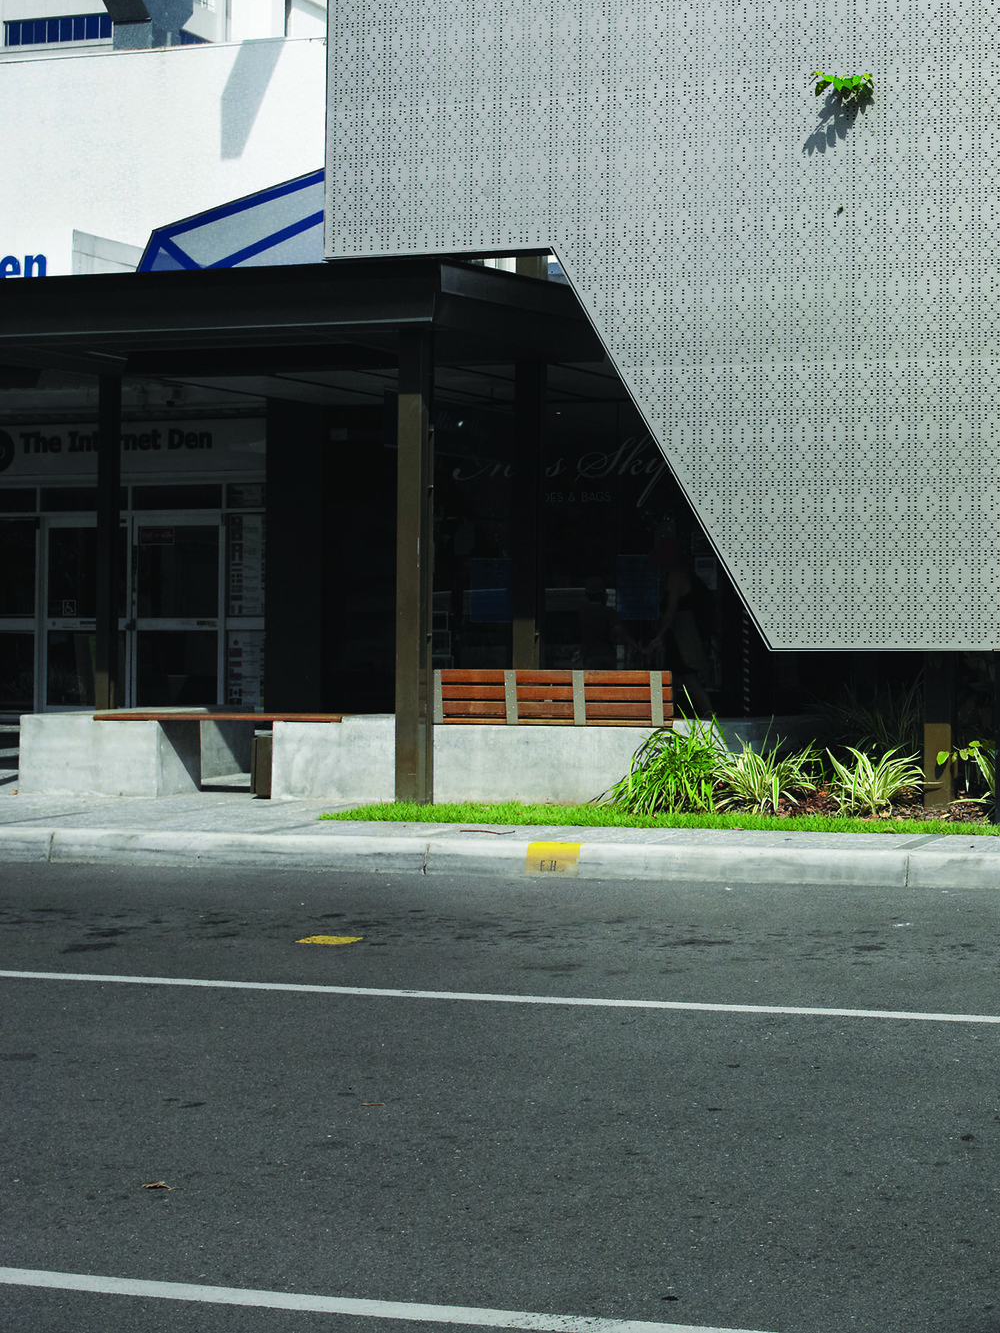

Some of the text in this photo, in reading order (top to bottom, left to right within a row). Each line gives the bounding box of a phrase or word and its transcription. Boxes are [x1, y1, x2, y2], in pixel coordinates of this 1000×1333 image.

[20, 428, 212, 453] The Intnet Den
[581, 491, 612, 503] BAGS
